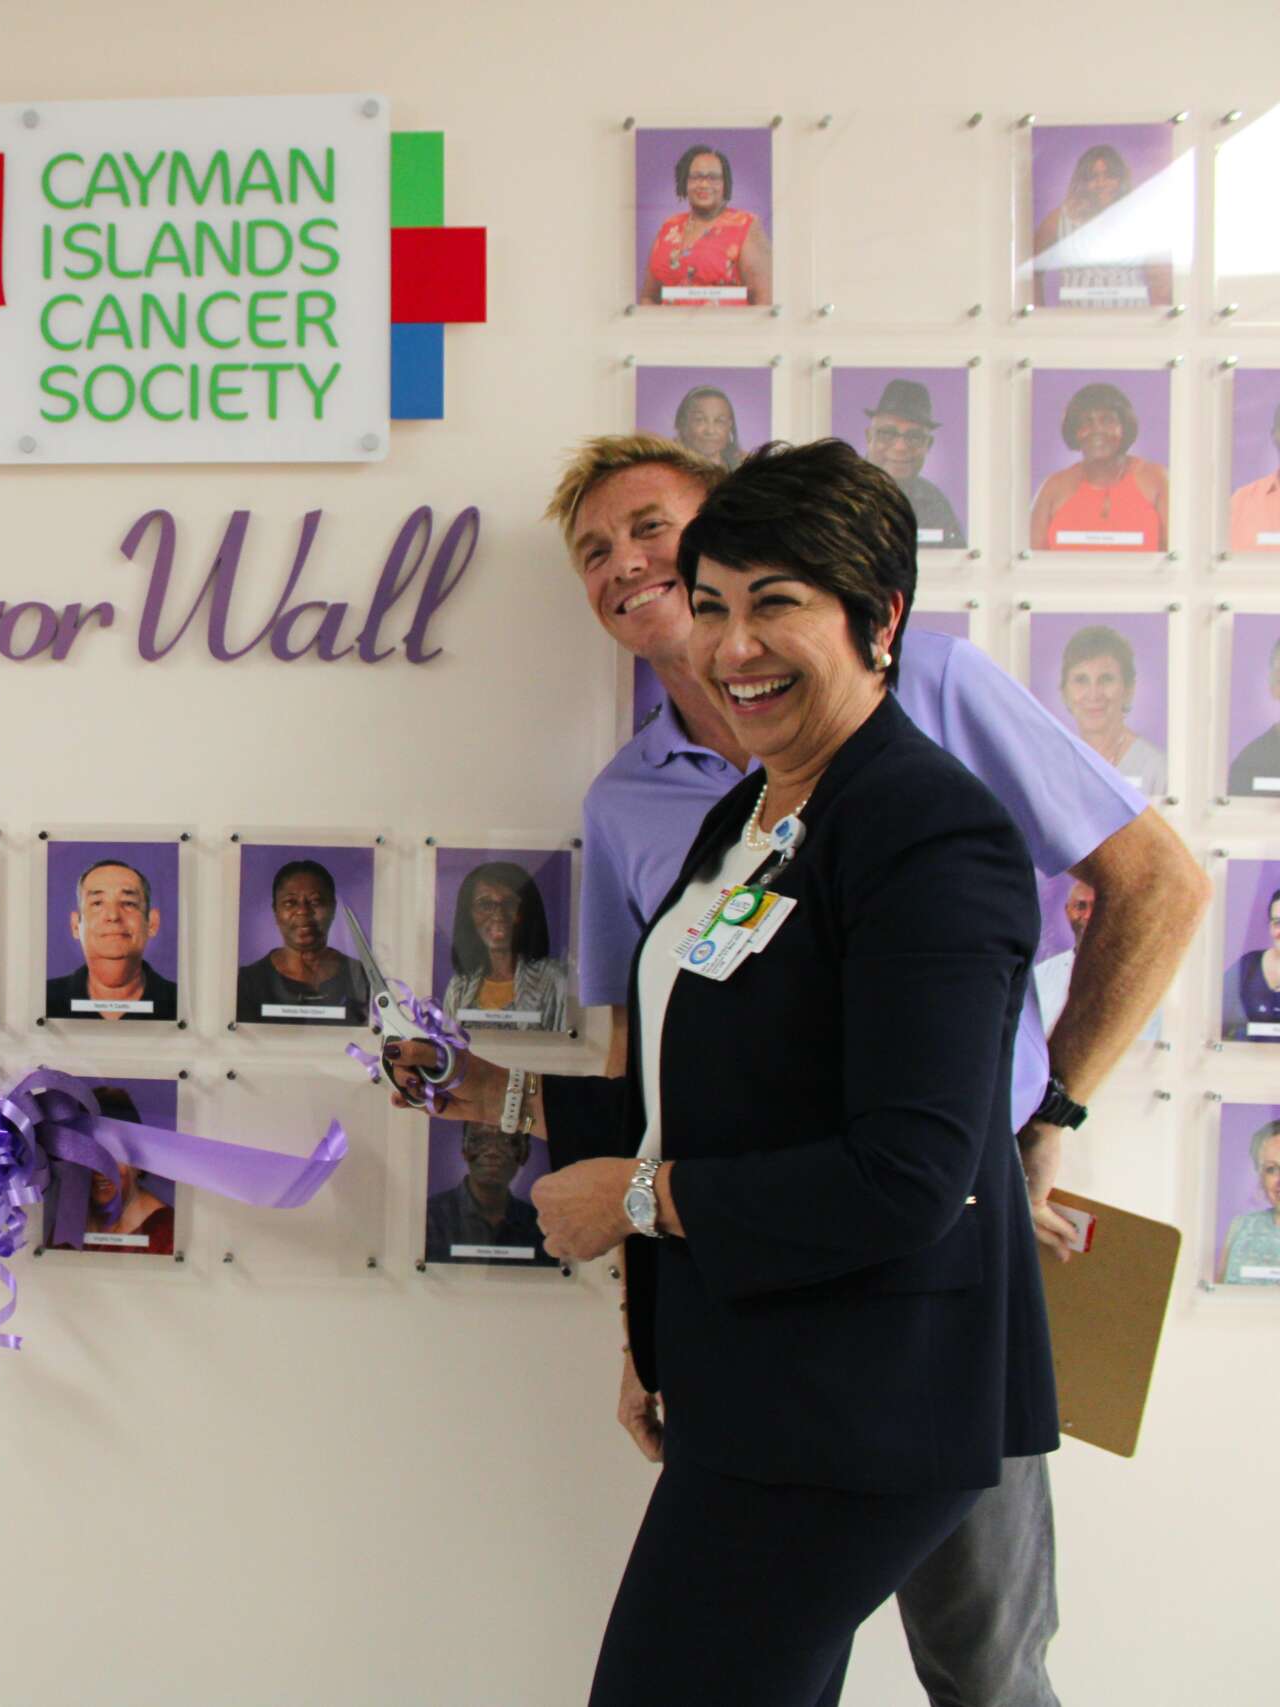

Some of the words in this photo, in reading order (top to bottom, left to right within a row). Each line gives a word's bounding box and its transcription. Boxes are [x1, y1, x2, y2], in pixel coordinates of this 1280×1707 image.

[41, 147, 336, 211] CAYMAN
[41, 217, 341, 281] ISLANDS
[39, 289, 338, 353] CANCER
[39, 362, 342, 424] SOCIETY
[120, 506, 480, 663] Wall
